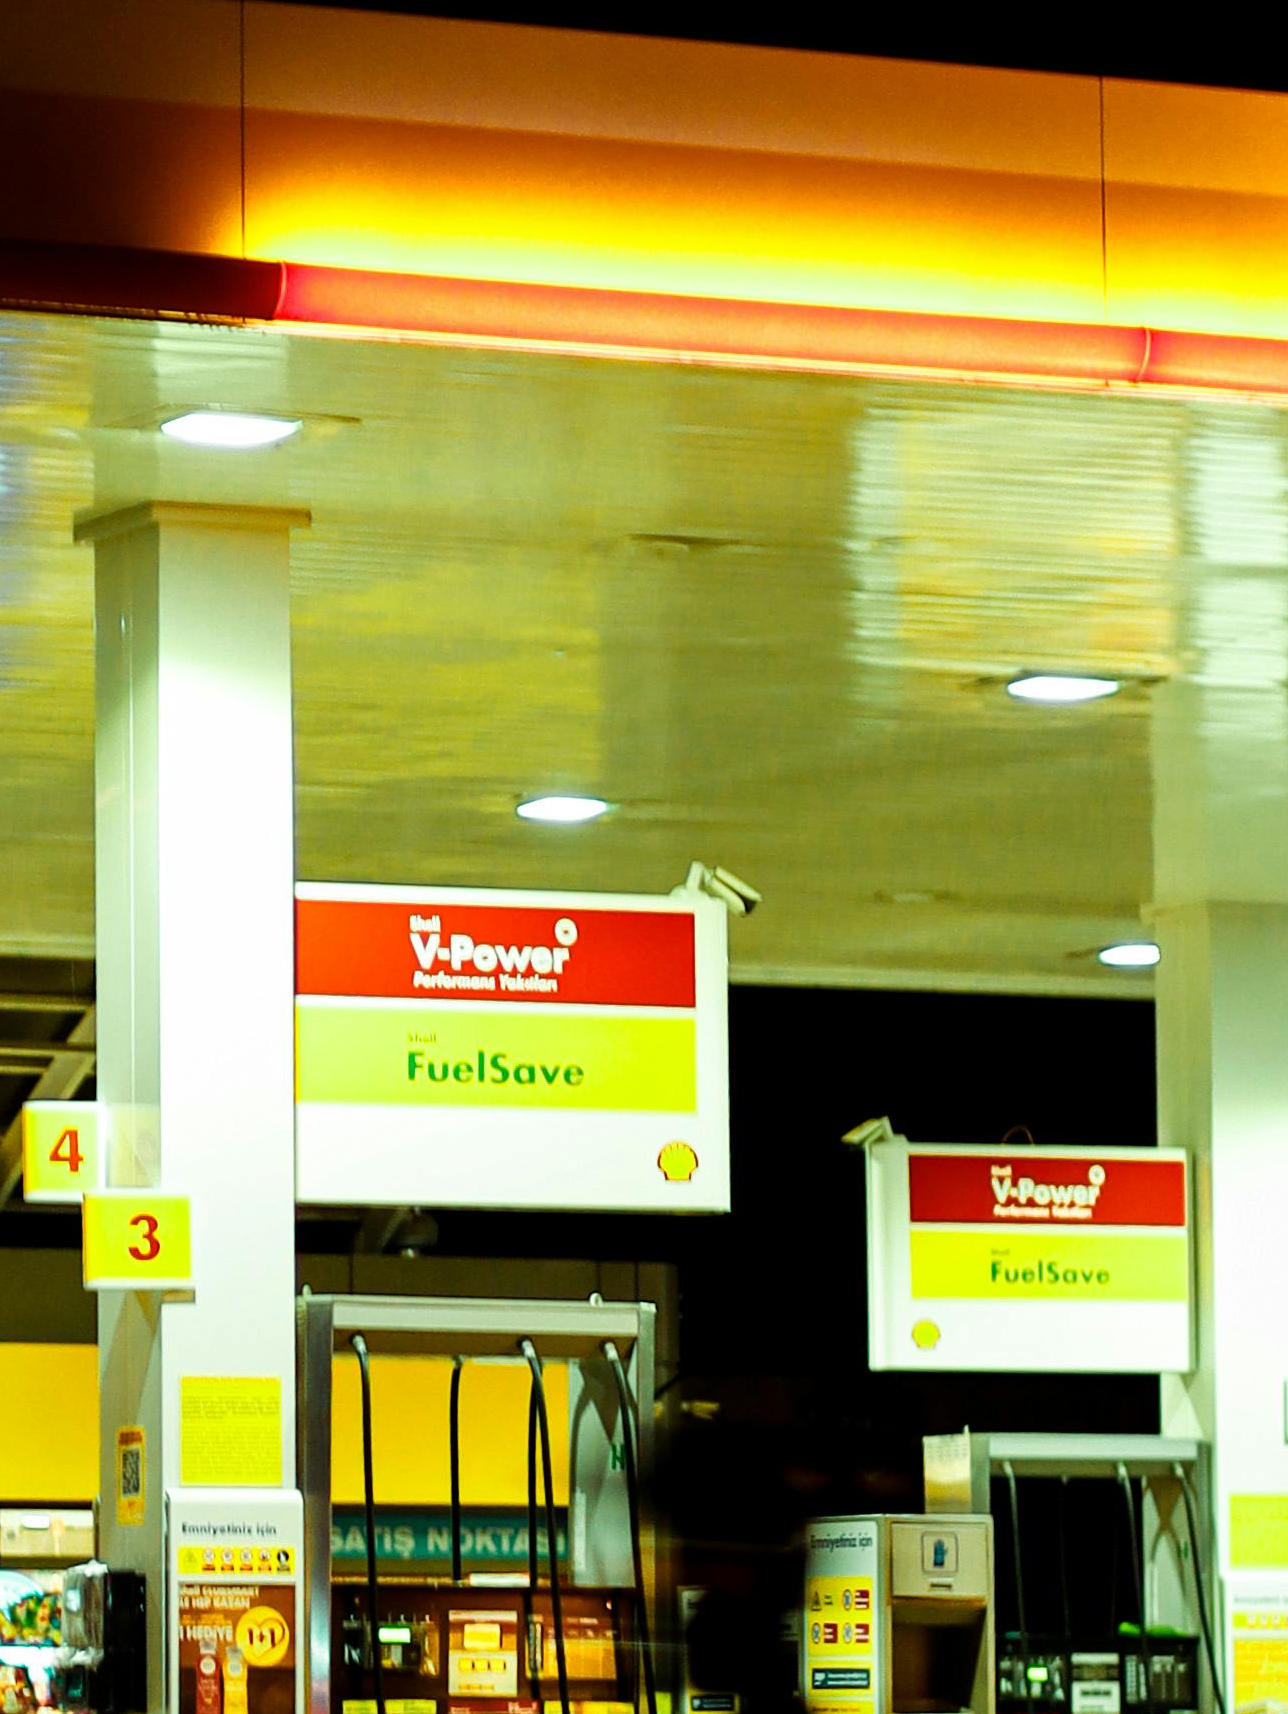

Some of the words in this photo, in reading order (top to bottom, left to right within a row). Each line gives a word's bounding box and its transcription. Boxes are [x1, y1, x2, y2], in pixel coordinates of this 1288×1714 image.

[409, 932, 570, 975] V-Power
[407, 1048, 585, 1086] FuelSave
[49, 1129, 84, 1173] 4
[991, 1176, 1101, 1206] V-Power
[128, 1213, 161, 1261] 3
[991, 1258, 1111, 1285] FuelSave
